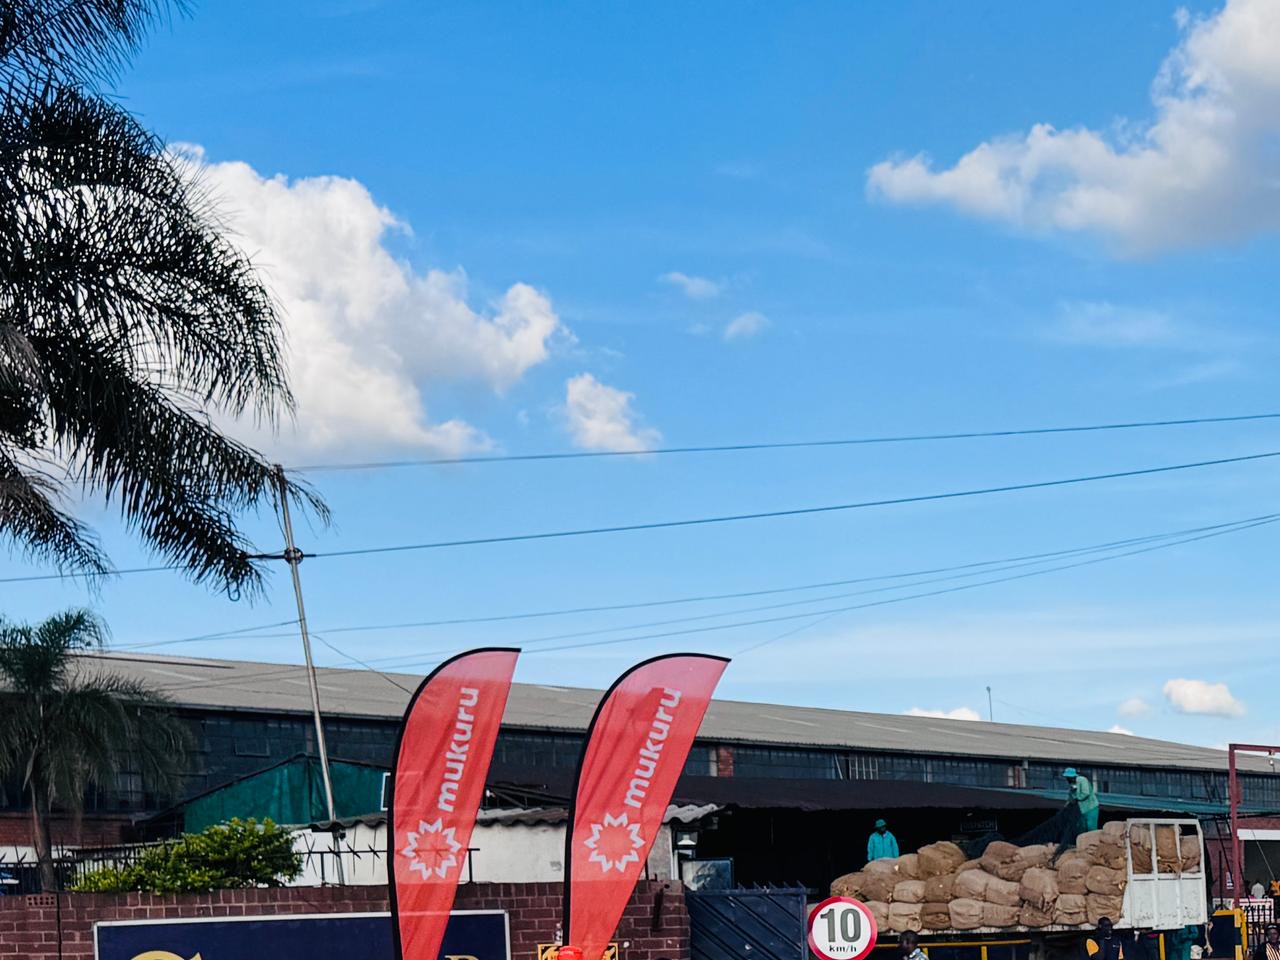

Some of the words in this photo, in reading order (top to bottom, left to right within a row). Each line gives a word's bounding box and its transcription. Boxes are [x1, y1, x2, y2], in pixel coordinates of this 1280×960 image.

[437, 687, 480, 813] mukuru
[624, 687, 682, 809] mukuru
[820, 908, 862, 943] 10
[829, 945, 857, 953] km/h
